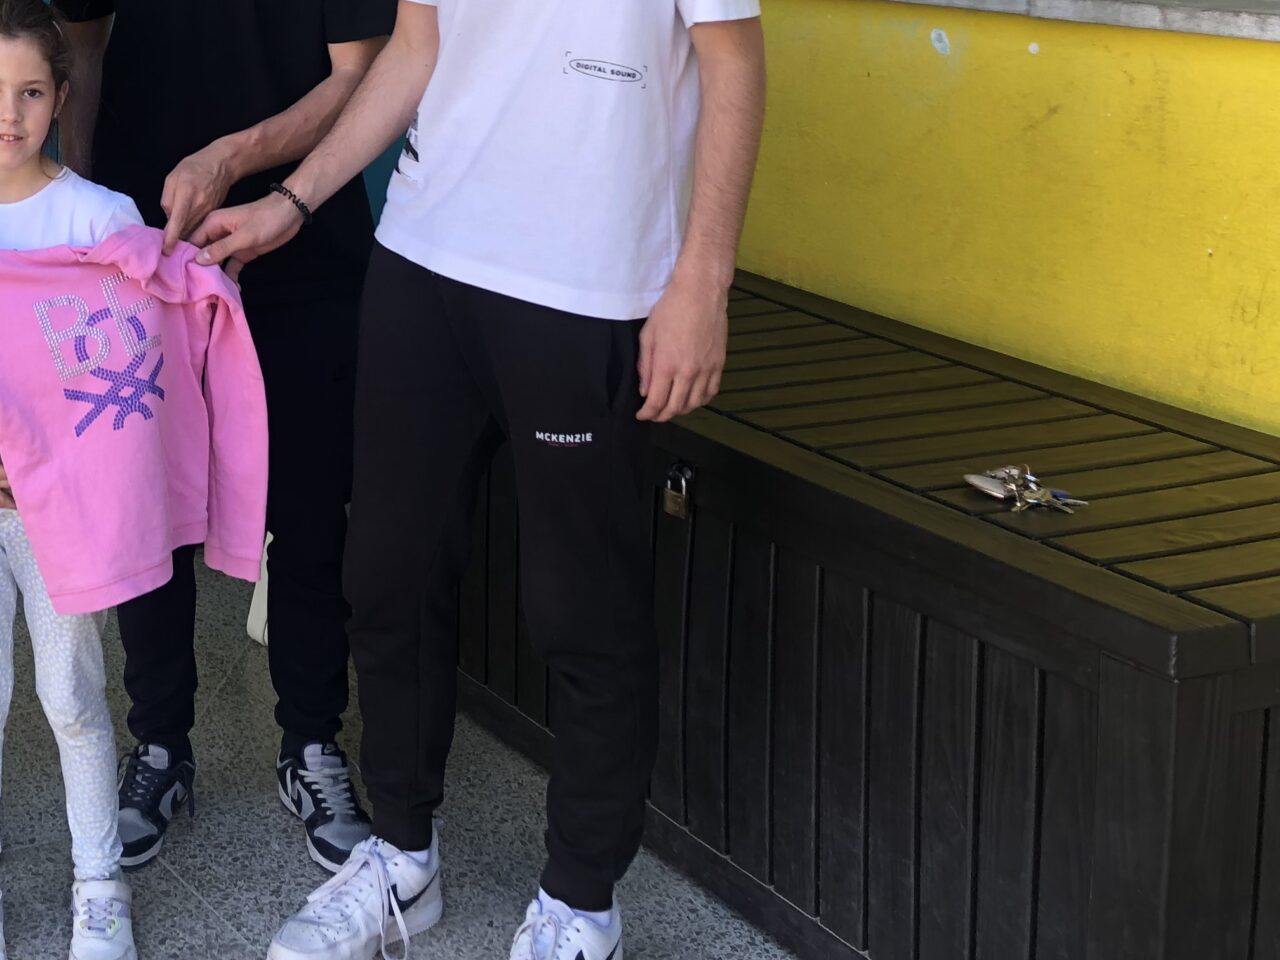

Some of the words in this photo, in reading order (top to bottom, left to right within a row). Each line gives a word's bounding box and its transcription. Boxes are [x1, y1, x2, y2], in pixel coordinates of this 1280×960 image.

[576, 62, 607, 74] DIGITAL
[610, 68, 637, 79] SOUND
[536, 430, 593, 443] MCKENZIE
